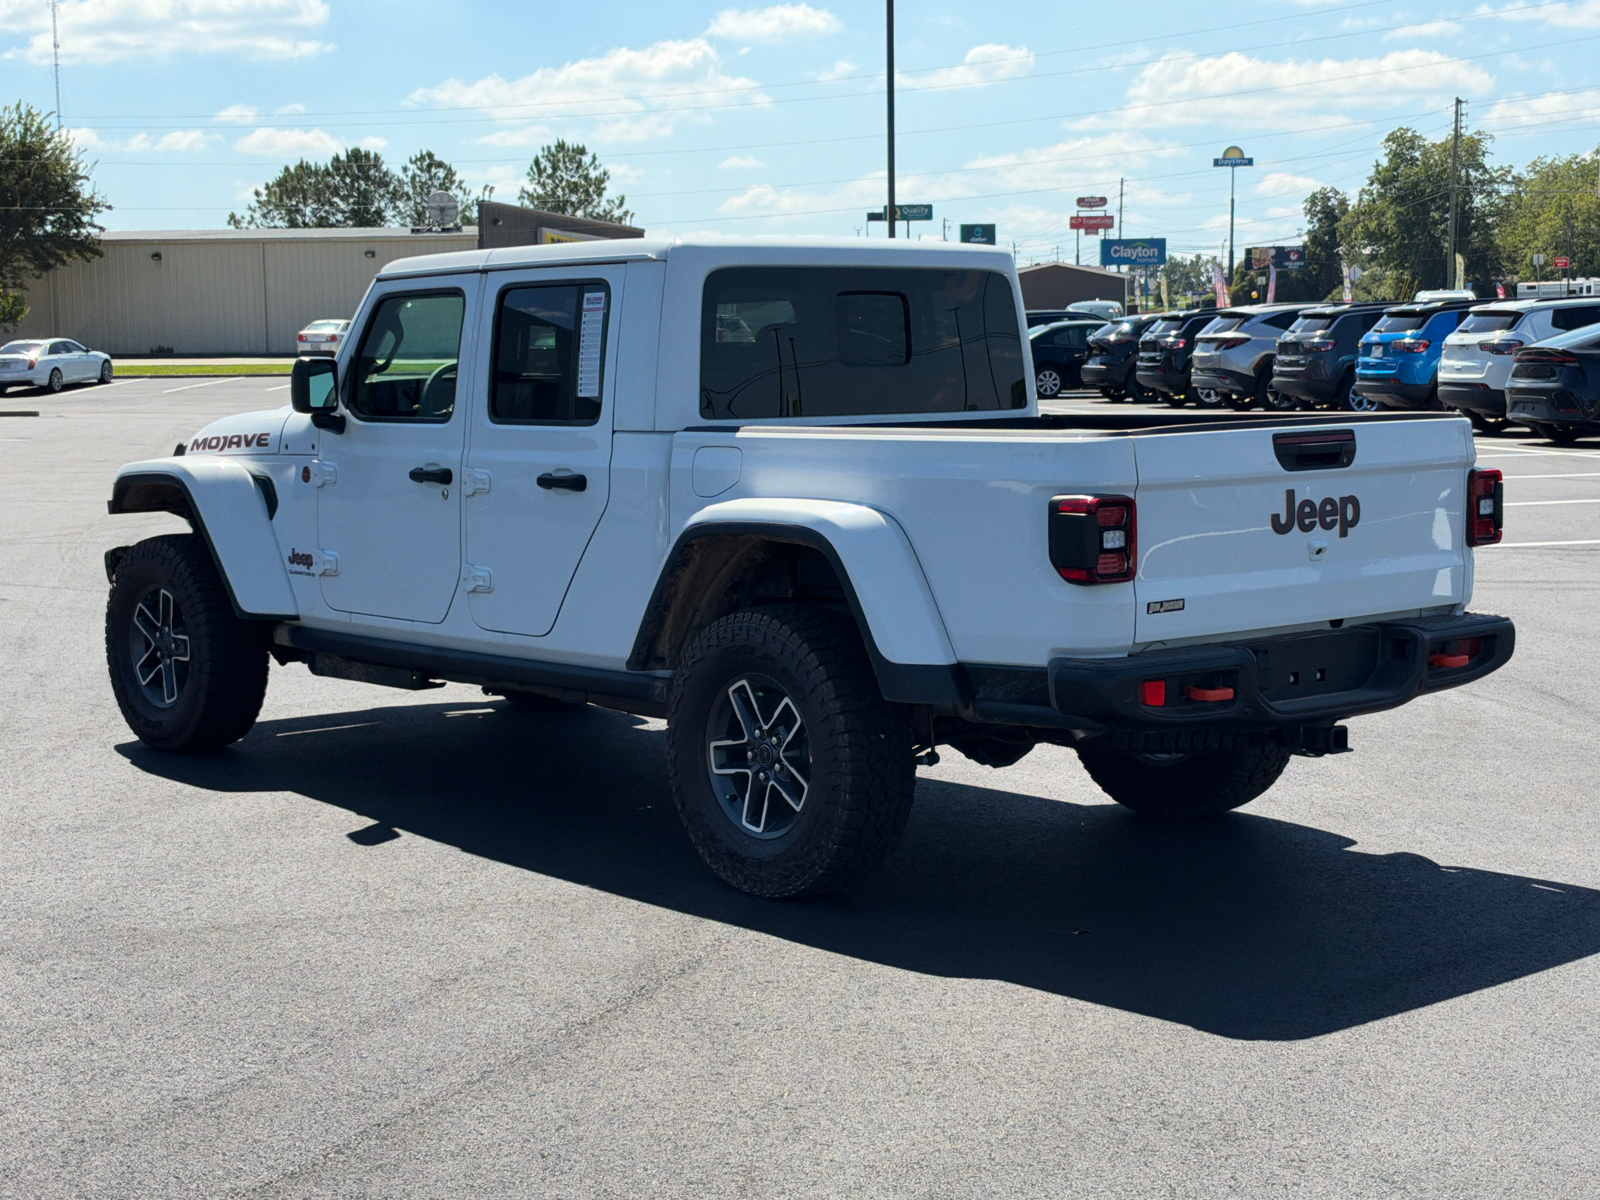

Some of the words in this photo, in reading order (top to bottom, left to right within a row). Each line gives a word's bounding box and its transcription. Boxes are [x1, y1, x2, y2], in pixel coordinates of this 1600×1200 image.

[1218, 158, 1235, 166] Days
[902, 206, 929, 215] Quality
[1110, 244, 1158, 259] Clayton
[190, 432, 271, 452] MOJAVE
[1270, 488, 1361, 538] Jeep
[288, 547, 314, 570] Jeep
